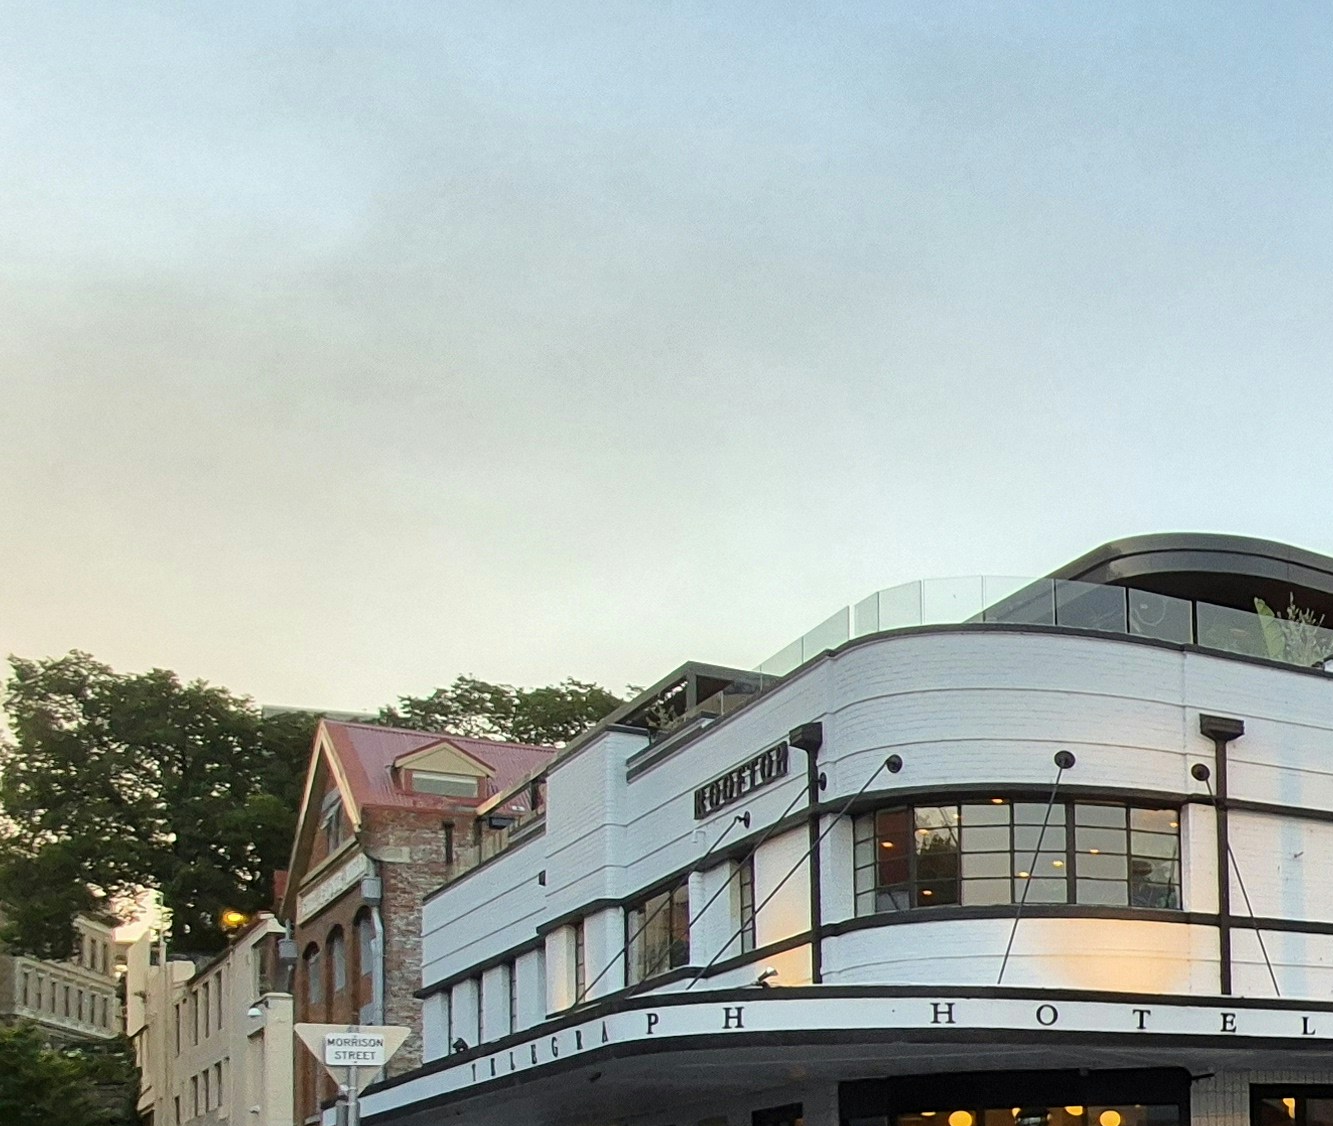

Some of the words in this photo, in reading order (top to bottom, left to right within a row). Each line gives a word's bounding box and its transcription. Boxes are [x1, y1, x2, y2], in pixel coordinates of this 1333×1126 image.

[327, 1038, 383, 1047] MORRISON
[471, 1006, 744, 1082] TELEGRAPH
[930, 1002, 1316, 1037] HOTEL
[334, 1050, 376, 1060] STREET
